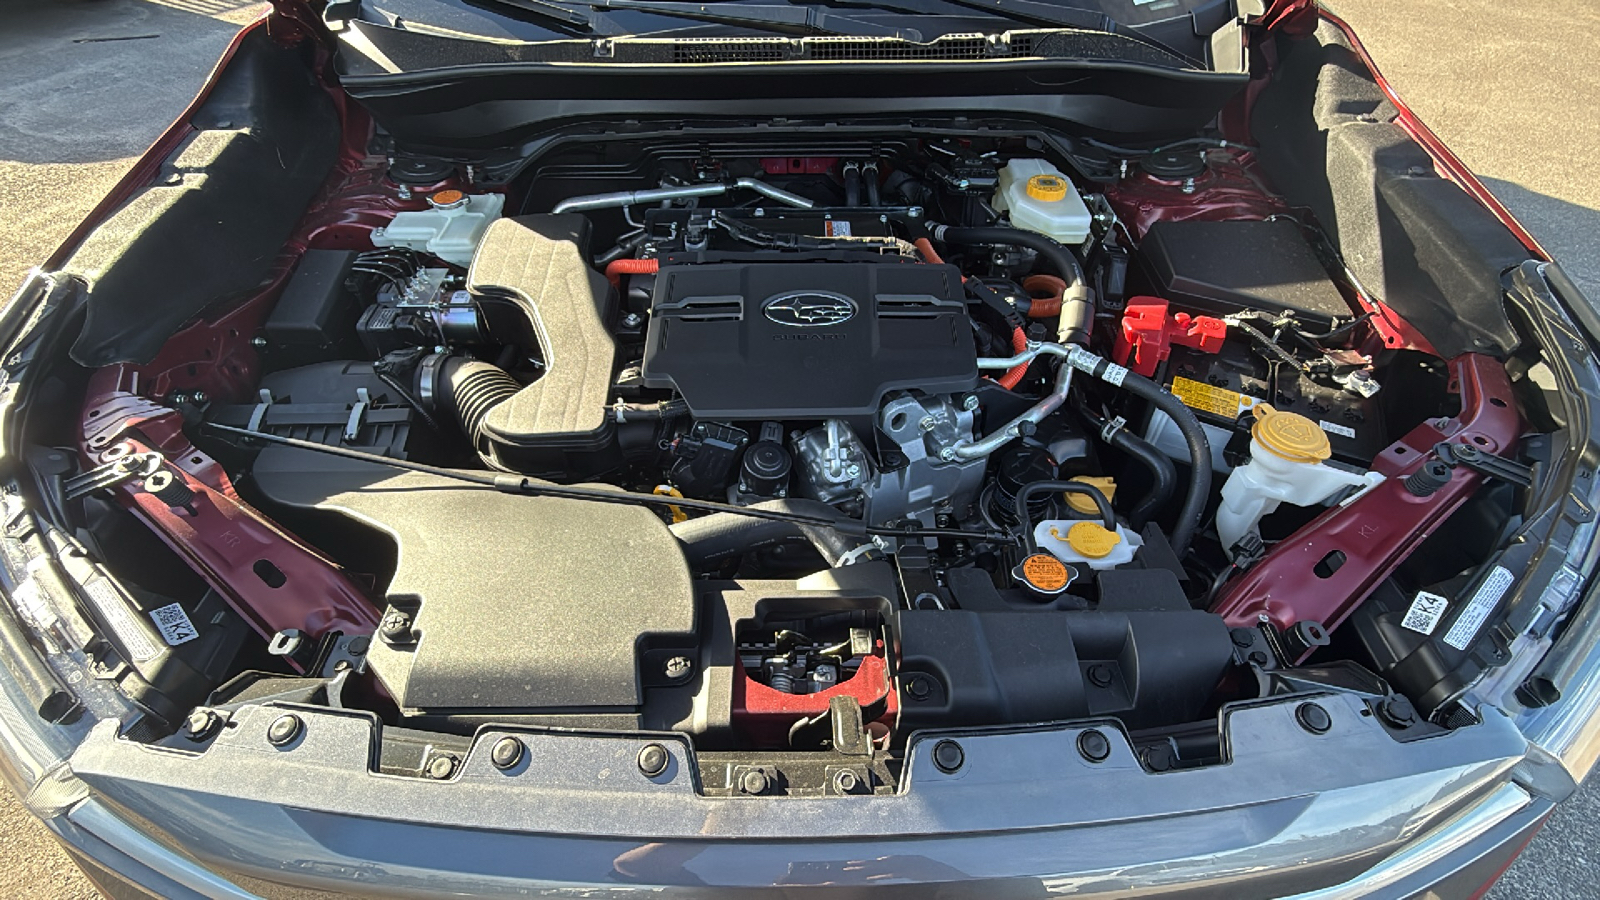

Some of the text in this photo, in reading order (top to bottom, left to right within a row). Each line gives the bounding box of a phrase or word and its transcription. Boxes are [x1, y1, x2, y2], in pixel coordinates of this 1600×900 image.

[772, 333, 847, 341] SUBARU
[220, 530, 240, 548] KR
[1357, 524, 1379, 539] KL
[1417, 595, 1440, 615] K4
[169, 621, 191, 642] K4
